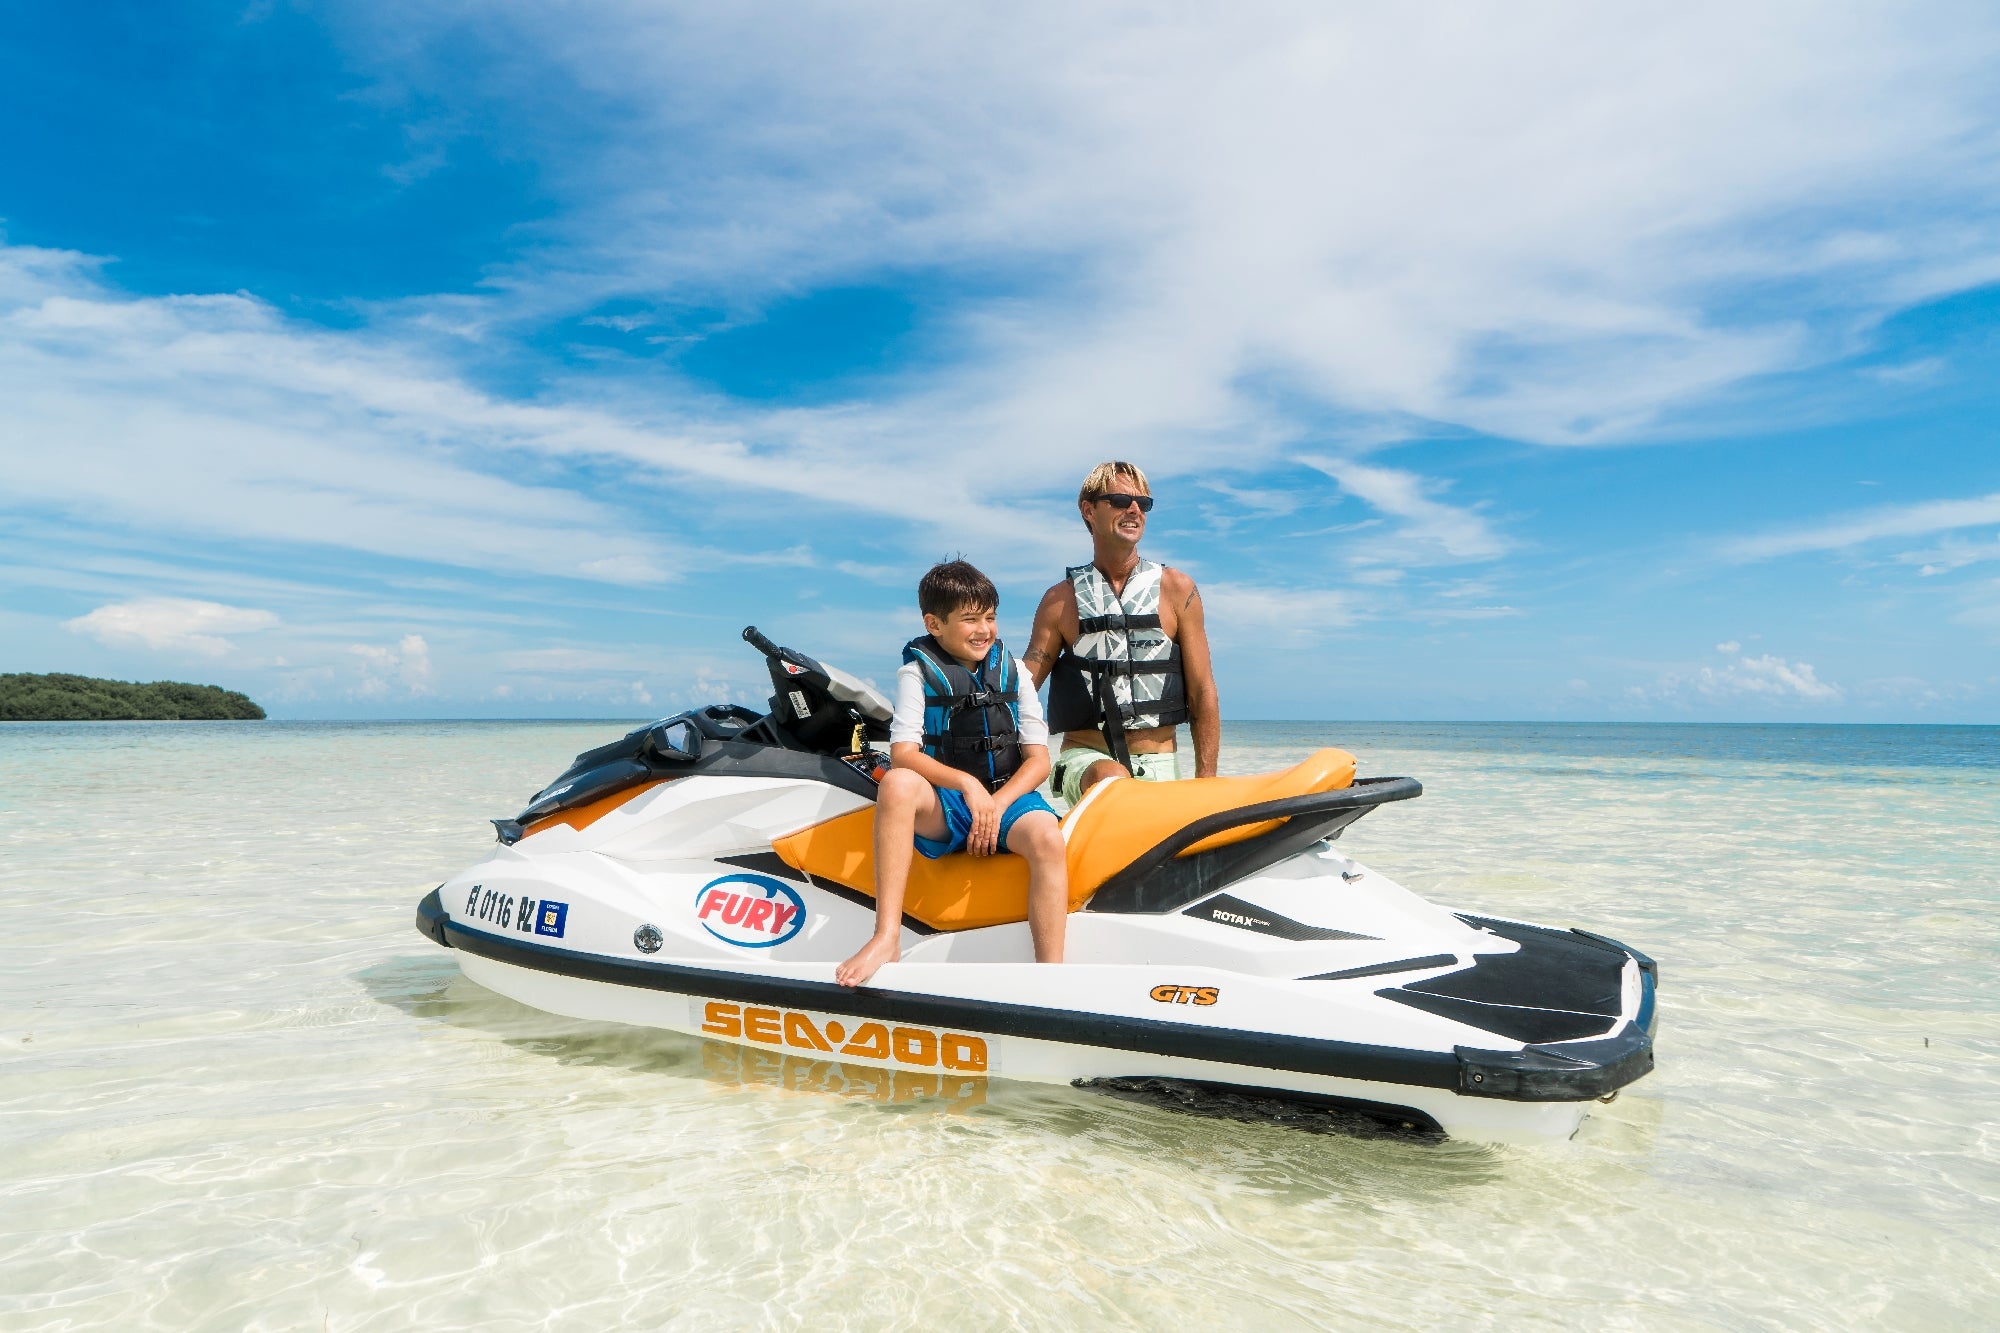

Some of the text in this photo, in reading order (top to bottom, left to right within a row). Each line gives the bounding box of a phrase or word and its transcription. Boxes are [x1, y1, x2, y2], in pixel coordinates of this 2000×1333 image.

[465, 885, 482, 916] FL
[480, 889, 514, 929] 0116
[698, 889, 800, 935] FURY
[1212, 909, 1253, 927] ROTAX
[1149, 984, 1220, 1006] GTS
